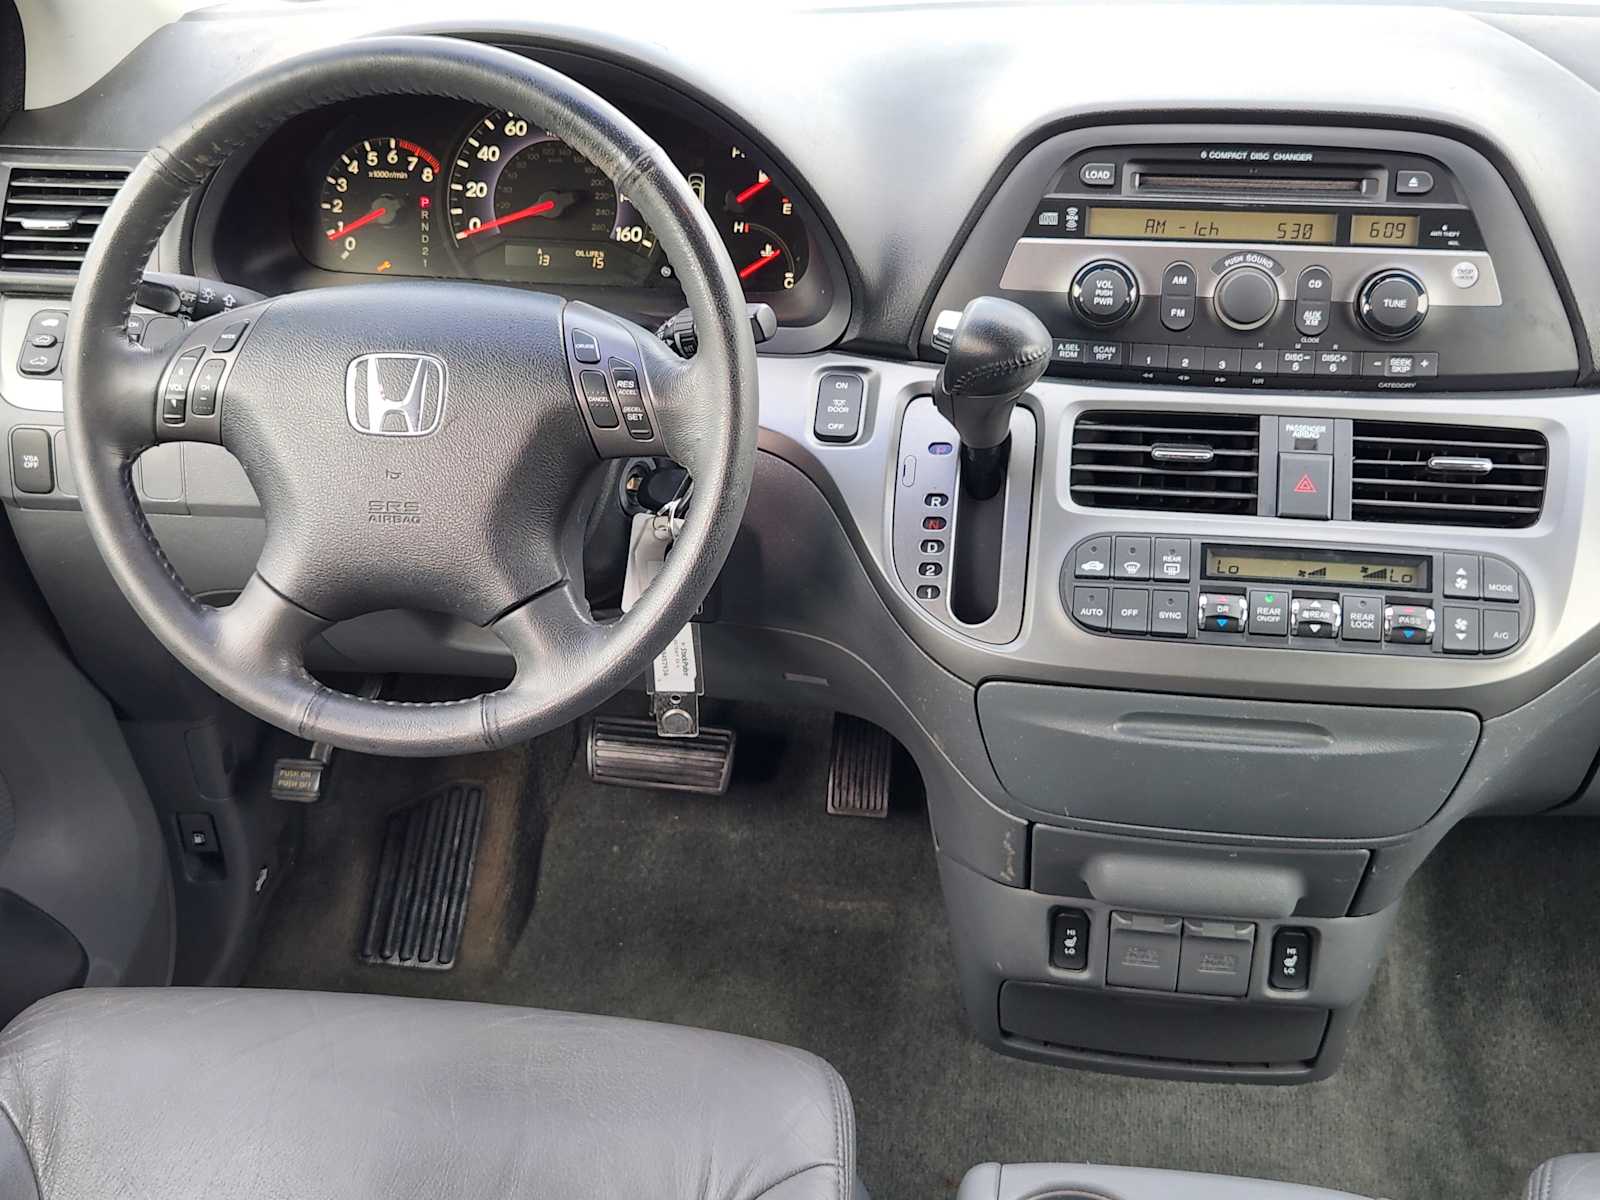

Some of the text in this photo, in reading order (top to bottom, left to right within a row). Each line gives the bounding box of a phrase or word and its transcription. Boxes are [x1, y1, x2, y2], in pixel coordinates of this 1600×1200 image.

[504, 120, 528, 136] 60
[368, 152, 378, 166] 5
[387, 150, 398, 164] 6
[477, 146, 500, 162] 40
[1209, 152, 1248, 160] COMPACT
[1273, 153, 1312, 161] CHANGER
[347, 161, 359, 174] 4
[407, 157, 418, 171] 7
[422, 168, 433, 182] 8
[1085, 170, 1111, 180] LOAD
[336, 178, 348, 192] 3
[466, 182, 488, 198] 20
[332, 200, 343, 213] 2
[420, 198, 430, 207] P
[783, 203, 792, 214] E
[421, 210, 429, 219] R
[337, 221, 344, 232] 1
[421, 223, 429, 232] N
[468, 217, 481, 230] 0
[734, 222, 744, 233] H
[1144, 219, 1166, 234] AM
[616, 226, 642, 242] 160
[1276, 223, 1314, 240] 530
[345, 237, 356, 250] 0
[422, 235, 429, 243] D
[422, 247, 429, 256] 2
[424, 259, 428, 268] 1
[1224, 254, 1274, 269] PUSH SOUND
[784, 278, 794, 289] C
[1096, 280, 1113, 289] VOL
[1172, 276, 1188, 285] AM
[1308, 280, 1322, 288] CD
[180, 291, 197, 302] OFF
[1094, 298, 1113, 306] PWR
[1384, 300, 1407, 309] TUNE
[1170, 308, 1186, 318] FM
[1303, 310, 1322, 320] AUX
[1093, 346, 1116, 354] SCAN
[1146, 356, 1151, 365] 1
[1182, 358, 1189, 368] 2
[1219, 360, 1226, 369] 3
[1255, 361, 1262, 370] 4
[1390, 357, 1412, 366] SEEK
[1292, 362, 1300, 371] 5
[1329, 363, 1337, 372] 6
[617, 380, 634, 388] RES
[368, 500, 420, 512] SRS
[930, 496, 941, 507] R
[368, 515, 420, 524] AIRBAG
[928, 519, 940, 530] N
[927, 542, 938, 553] D
[925, 565, 936, 576] 2
[1216, 559, 1239, 574] Lo
[926, 588, 932, 598] 1
[1488, 584, 1513, 592] MODE
[1081, 608, 1103, 616] AUTO
[1121, 608, 1138, 616] OFF
[1159, 612, 1181, 620] SYNC
[1257, 607, 1280, 615] REAR
[1493, 631, 1509, 640] A/C
